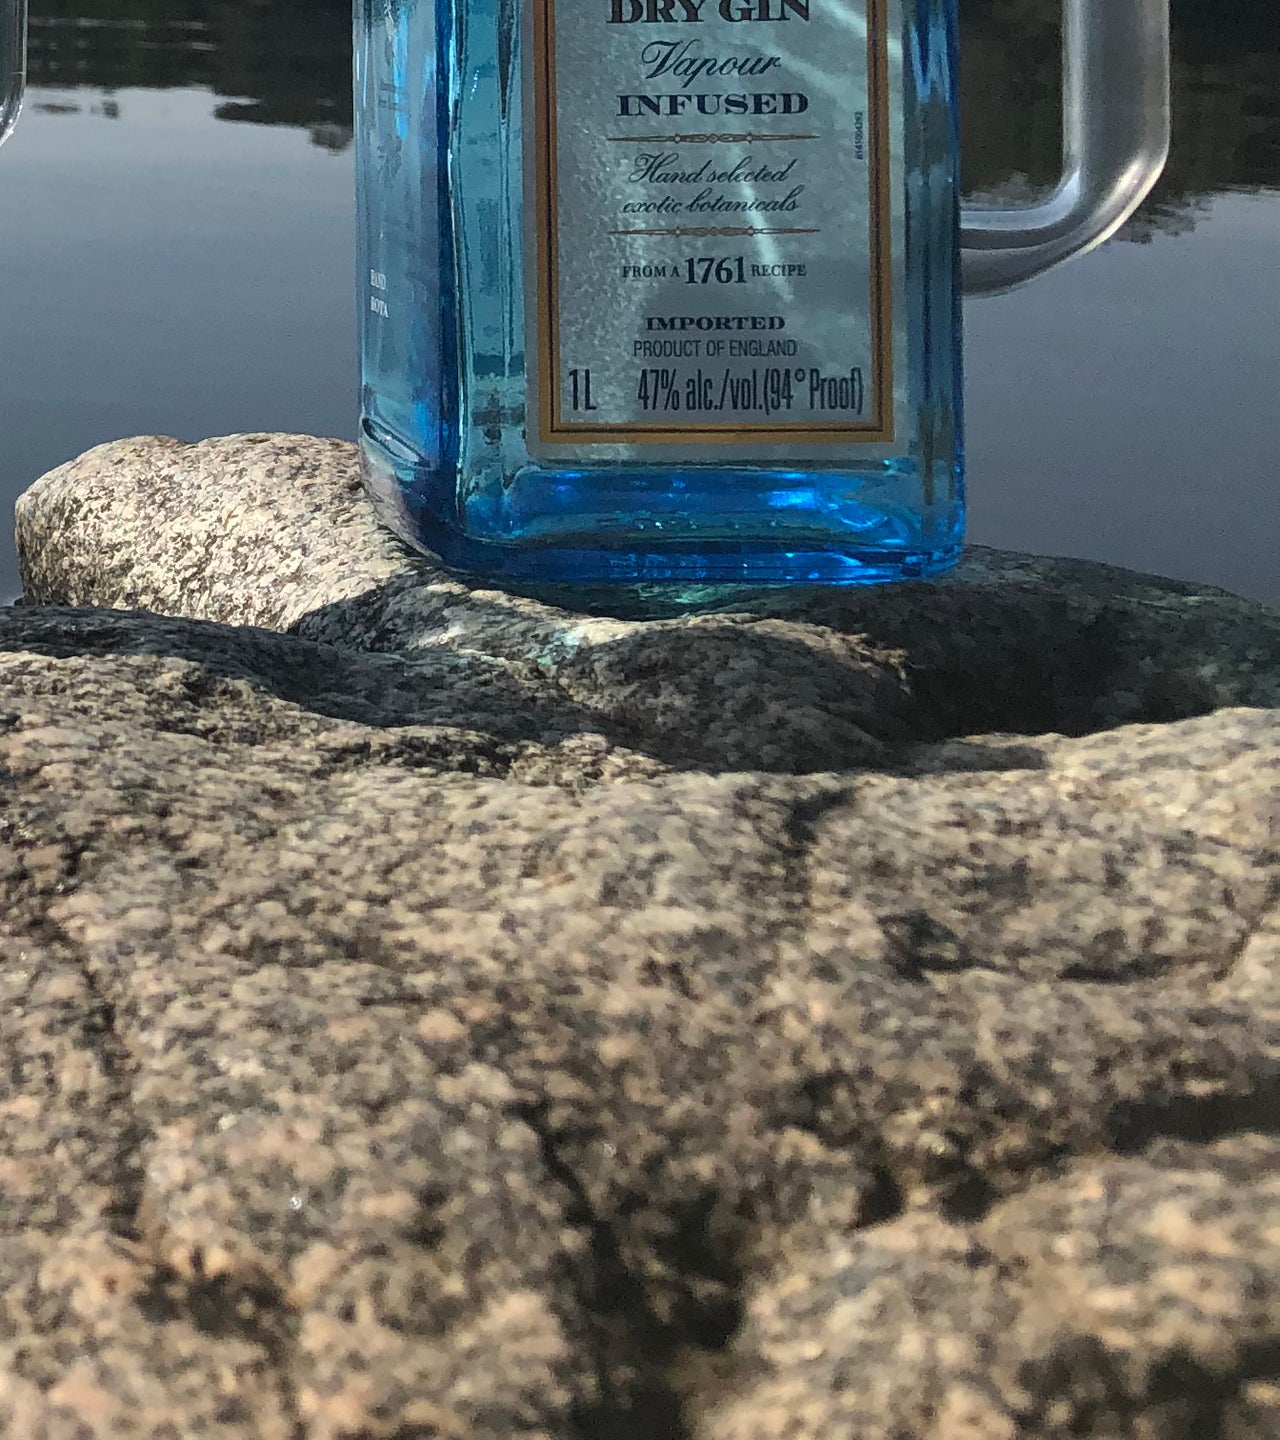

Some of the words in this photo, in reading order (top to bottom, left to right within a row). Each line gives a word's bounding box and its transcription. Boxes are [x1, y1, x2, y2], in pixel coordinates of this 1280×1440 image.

[640, 38, 782, 89] Vapour
[616, 93, 810, 118] INFUSED
[628, 152, 707, 184] Hand
[706, 157, 797, 184] selected
[622, 192, 682, 214] exotic
[683, 185, 804, 214] botanicals
[622, 265, 668, 279] FROM
[670, 266, 680, 278] A
[684, 256, 747, 285] 1761
[751, 264, 807, 278] RECIPE
[646, 315, 786, 332] IMPORTED
[633, 340, 703, 358] PRODUCT
[707, 340, 725, 357] OF
[729, 339, 797, 357] ENGLAND
[637, 368, 681, 412] 47%
